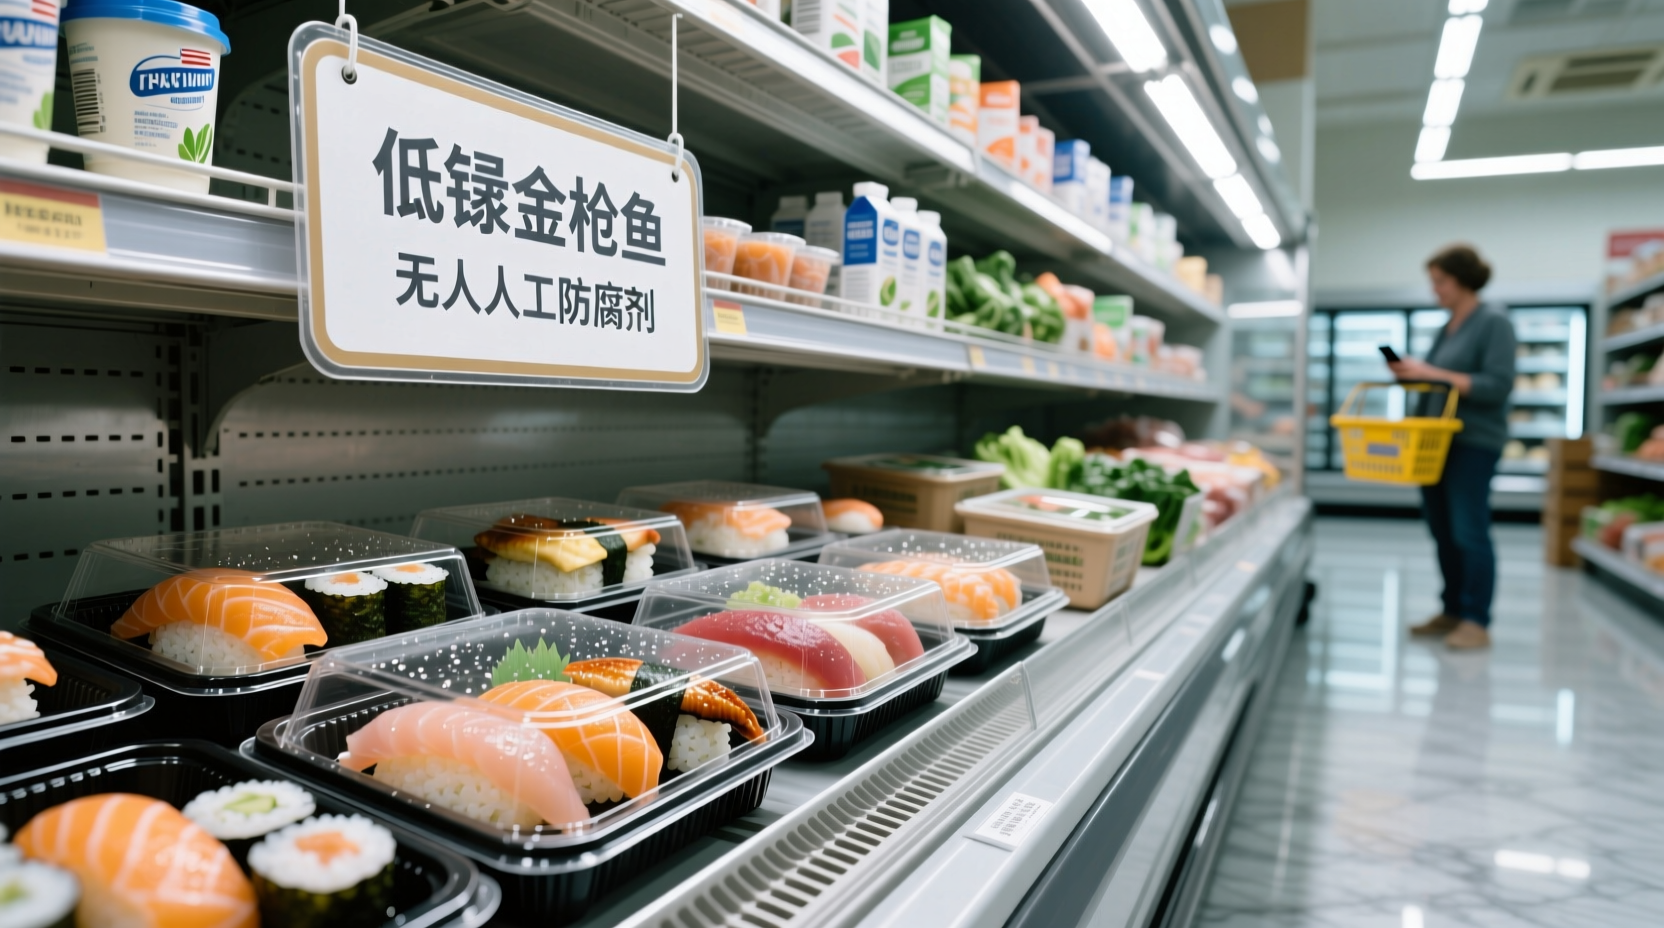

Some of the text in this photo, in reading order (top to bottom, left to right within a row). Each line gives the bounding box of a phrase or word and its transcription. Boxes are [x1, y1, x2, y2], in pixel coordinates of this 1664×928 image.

[396, 252, 655, 334] 无人人工防腐剂
